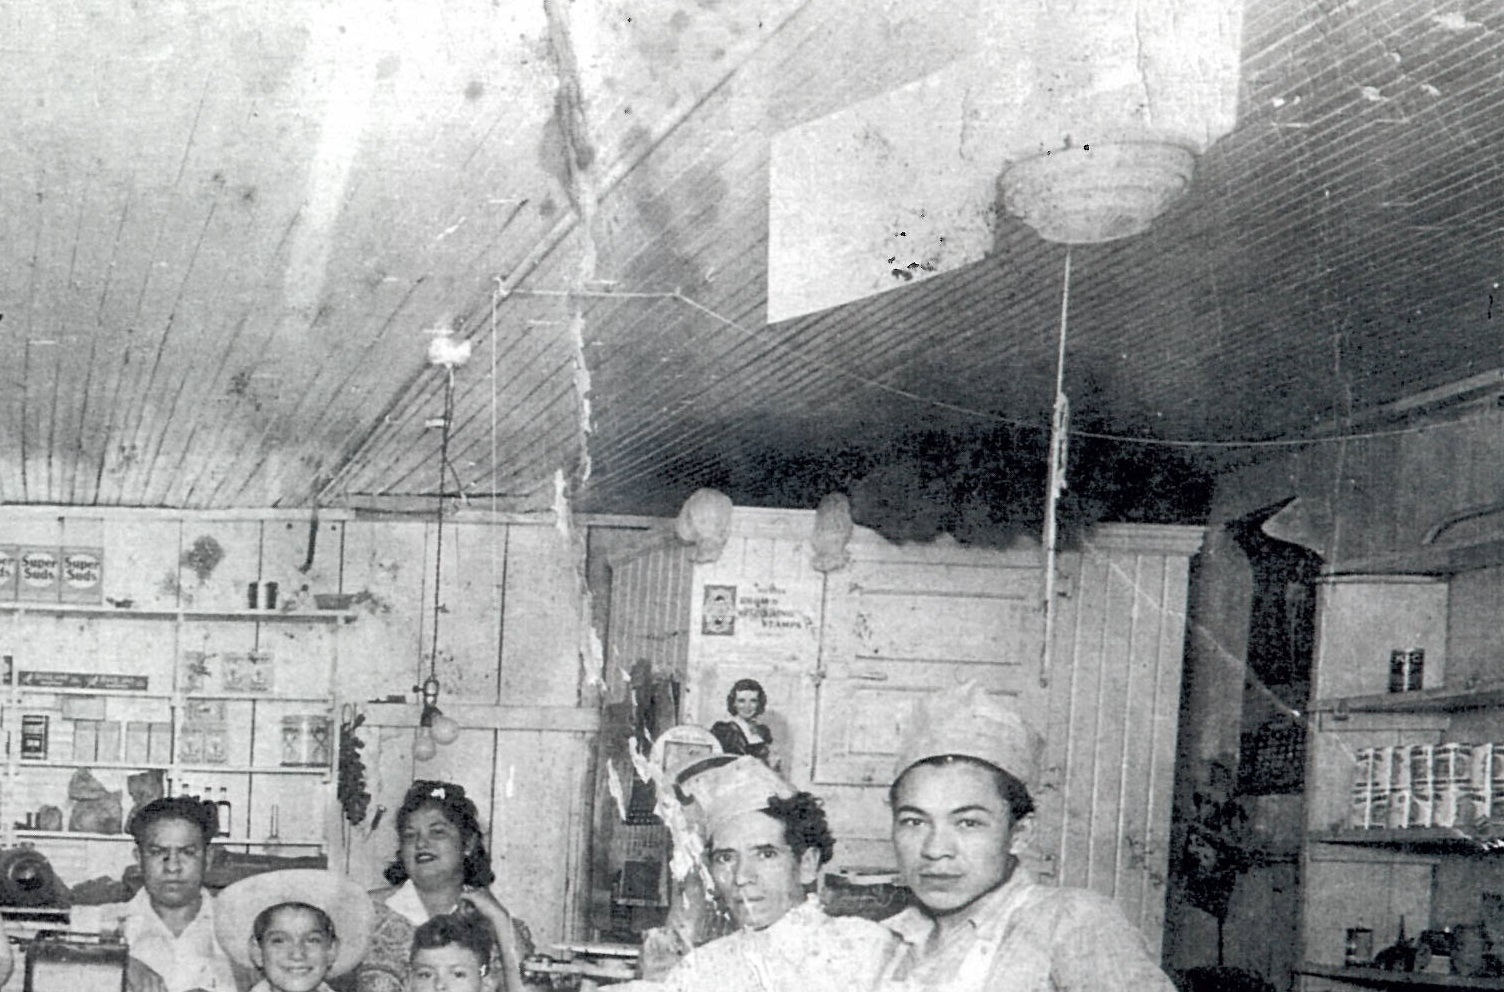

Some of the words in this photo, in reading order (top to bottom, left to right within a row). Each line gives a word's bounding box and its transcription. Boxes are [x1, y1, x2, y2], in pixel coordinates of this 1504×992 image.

[22, 555, 57, 569] Super
[64, 556, 100, 572] Super
[23, 567, 55, 581] Suds
[66, 569, 97, 583] Suds
